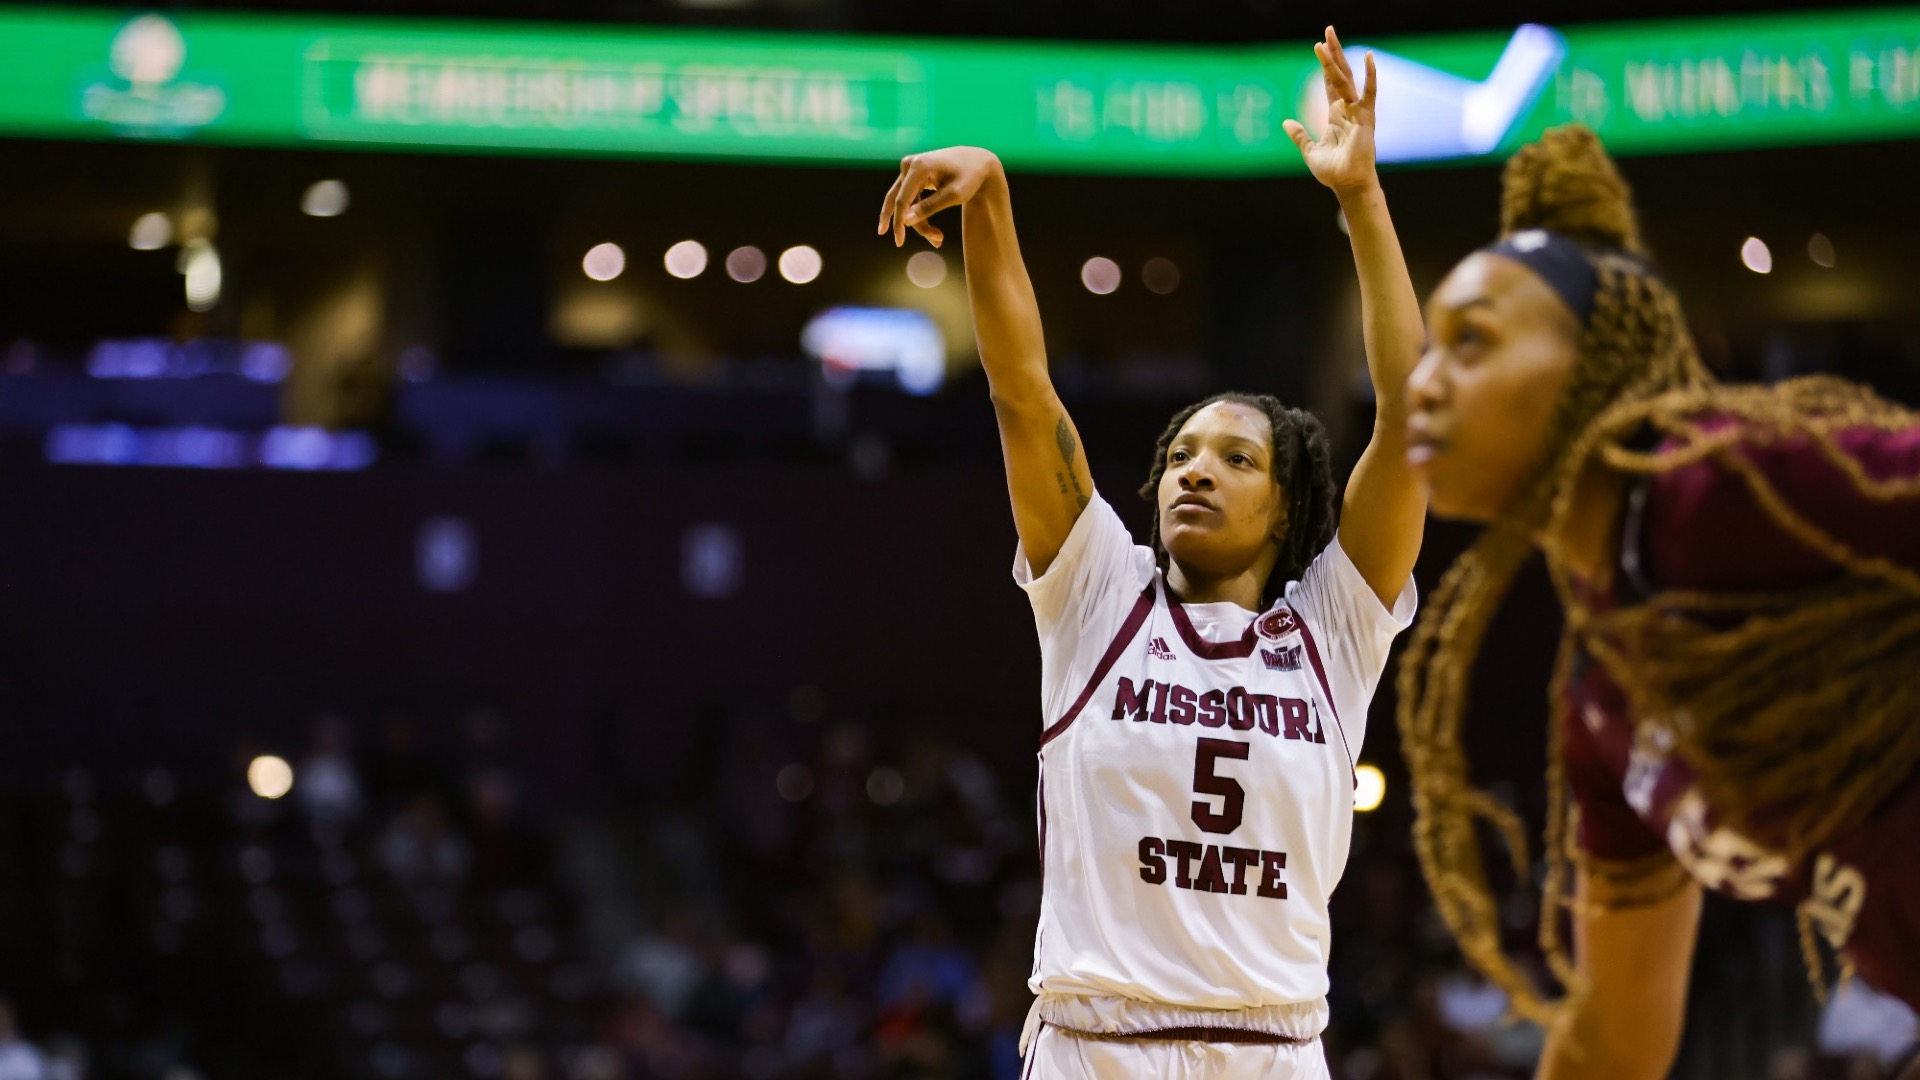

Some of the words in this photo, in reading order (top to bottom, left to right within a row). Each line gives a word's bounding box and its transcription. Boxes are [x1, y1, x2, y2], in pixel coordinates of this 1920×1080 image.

[1148, 646, 1176, 661] adidas
[1191, 737, 1249, 835] 5
[1138, 836, 1288, 899] STATE
